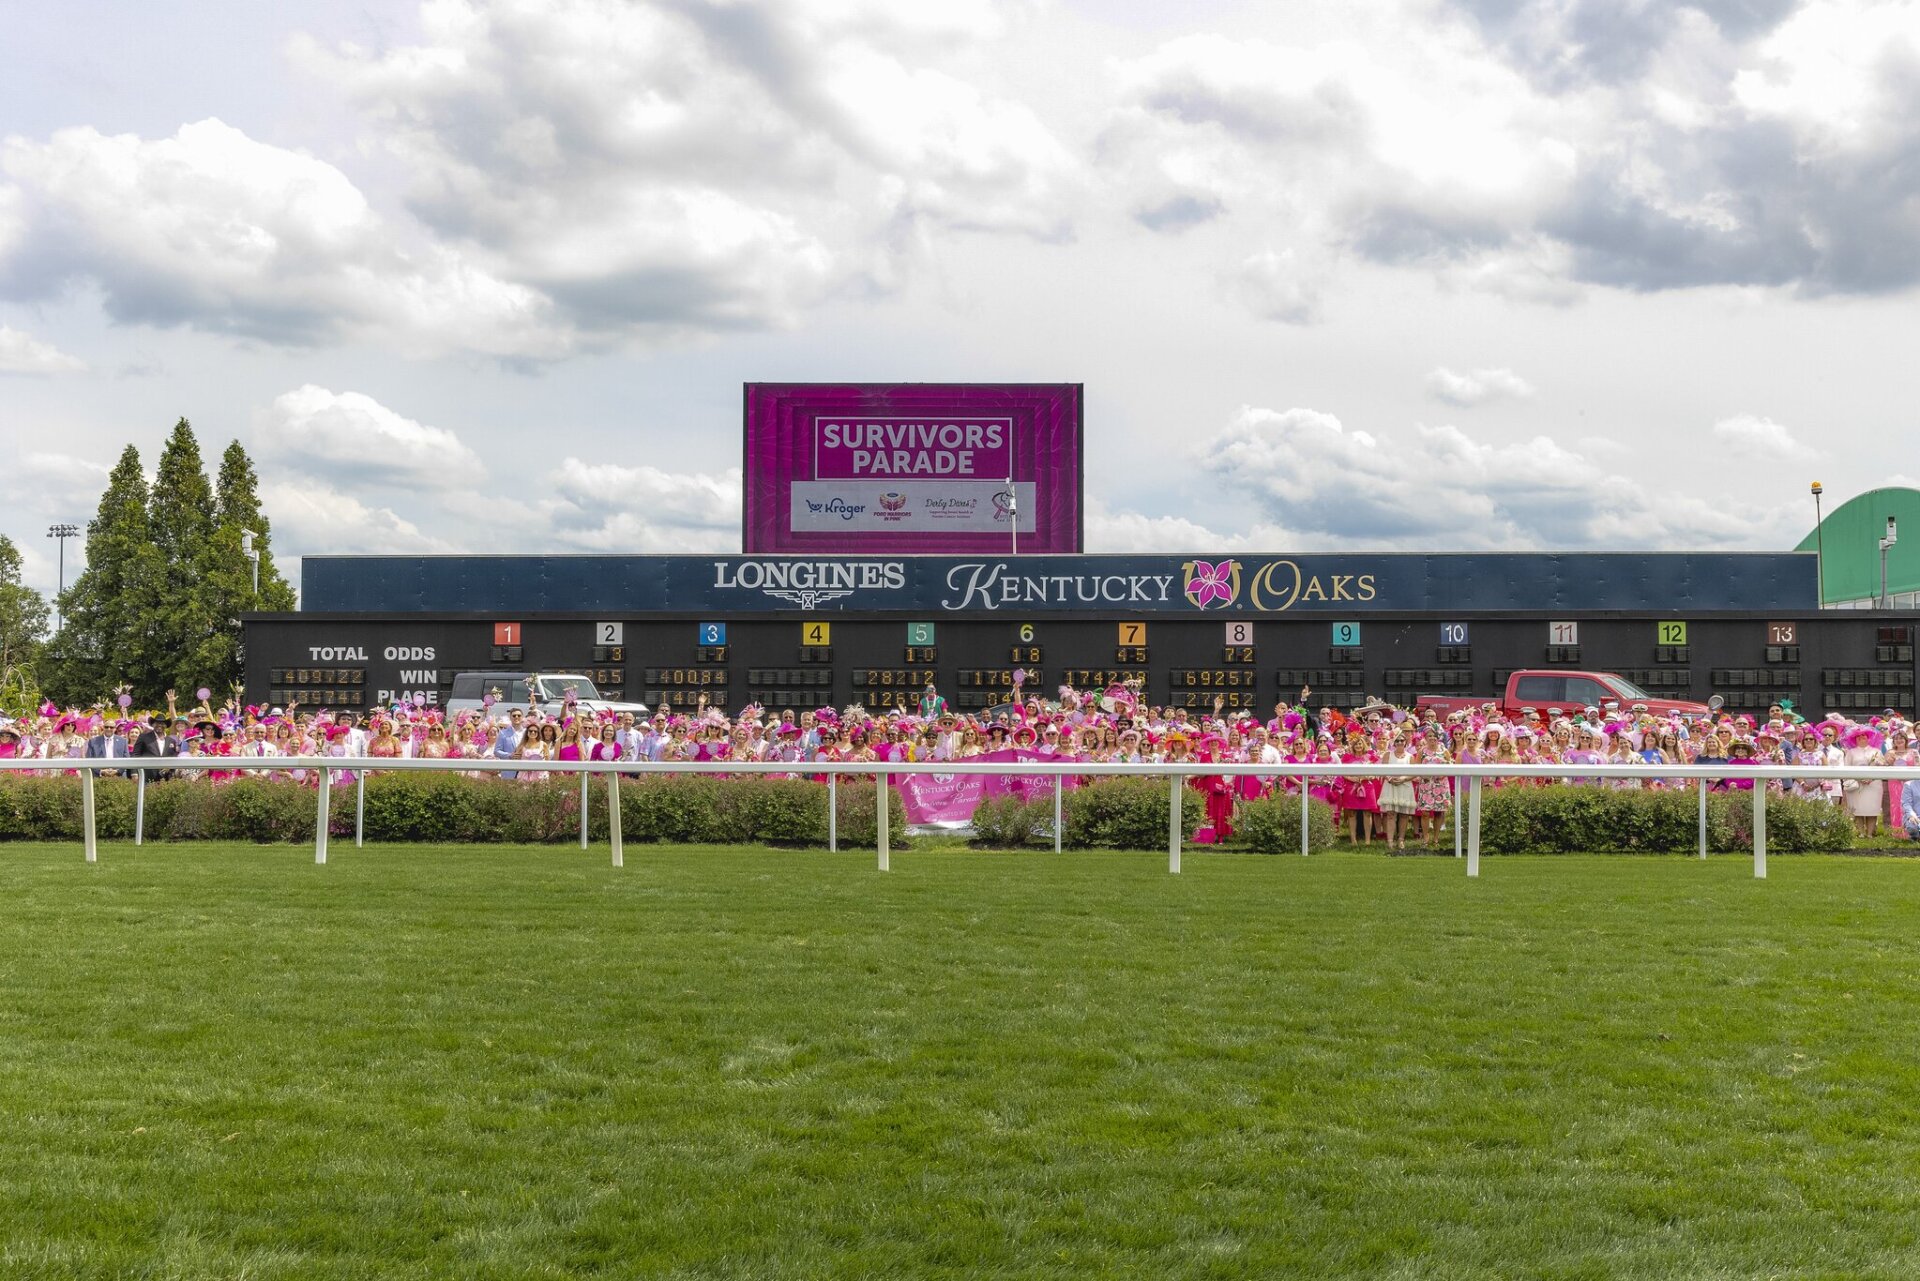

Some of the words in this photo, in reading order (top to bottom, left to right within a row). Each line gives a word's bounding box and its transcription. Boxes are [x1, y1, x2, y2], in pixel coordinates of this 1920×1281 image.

[824, 424, 1003, 449] SURVIVORS
[853, 450, 975, 475] PARADE
[825, 497, 866, 521] Kroger
[713, 561, 906, 589] LONGINES
[941, 562, 1174, 611] KENTUCKY
[1250, 560, 1376, 611] OAKS
[503, 625, 511, 643] 1
[605, 624, 615, 642] 2
[707, 624, 718, 643] 3
[810, 624, 823, 642] 4
[915, 624, 927, 642] 5
[1020, 624, 1034, 642] 6
[1126, 625, 1139, 643] 7
[1233, 624, 1245, 642] 8
[1341, 624, 1352, 642] 9
[1445, 625, 1465, 642] 10
[1554, 625, 1573, 642] 11
[1662, 625, 1682, 642] 12
[1773, 626, 1792, 642] 13
[309, 647, 369, 661] TOTAL
[384, 646, 436, 661] ODDS
[612, 647, 622, 661] 3
[400, 669, 437, 684] WIN
[660, 669, 725, 684] 40084
[868, 670, 934, 685] 28212
[1186, 671, 1253, 686] 69257
[910, 784, 954, 796] KENTUCKY
[955, 781, 981, 793] OAKS
